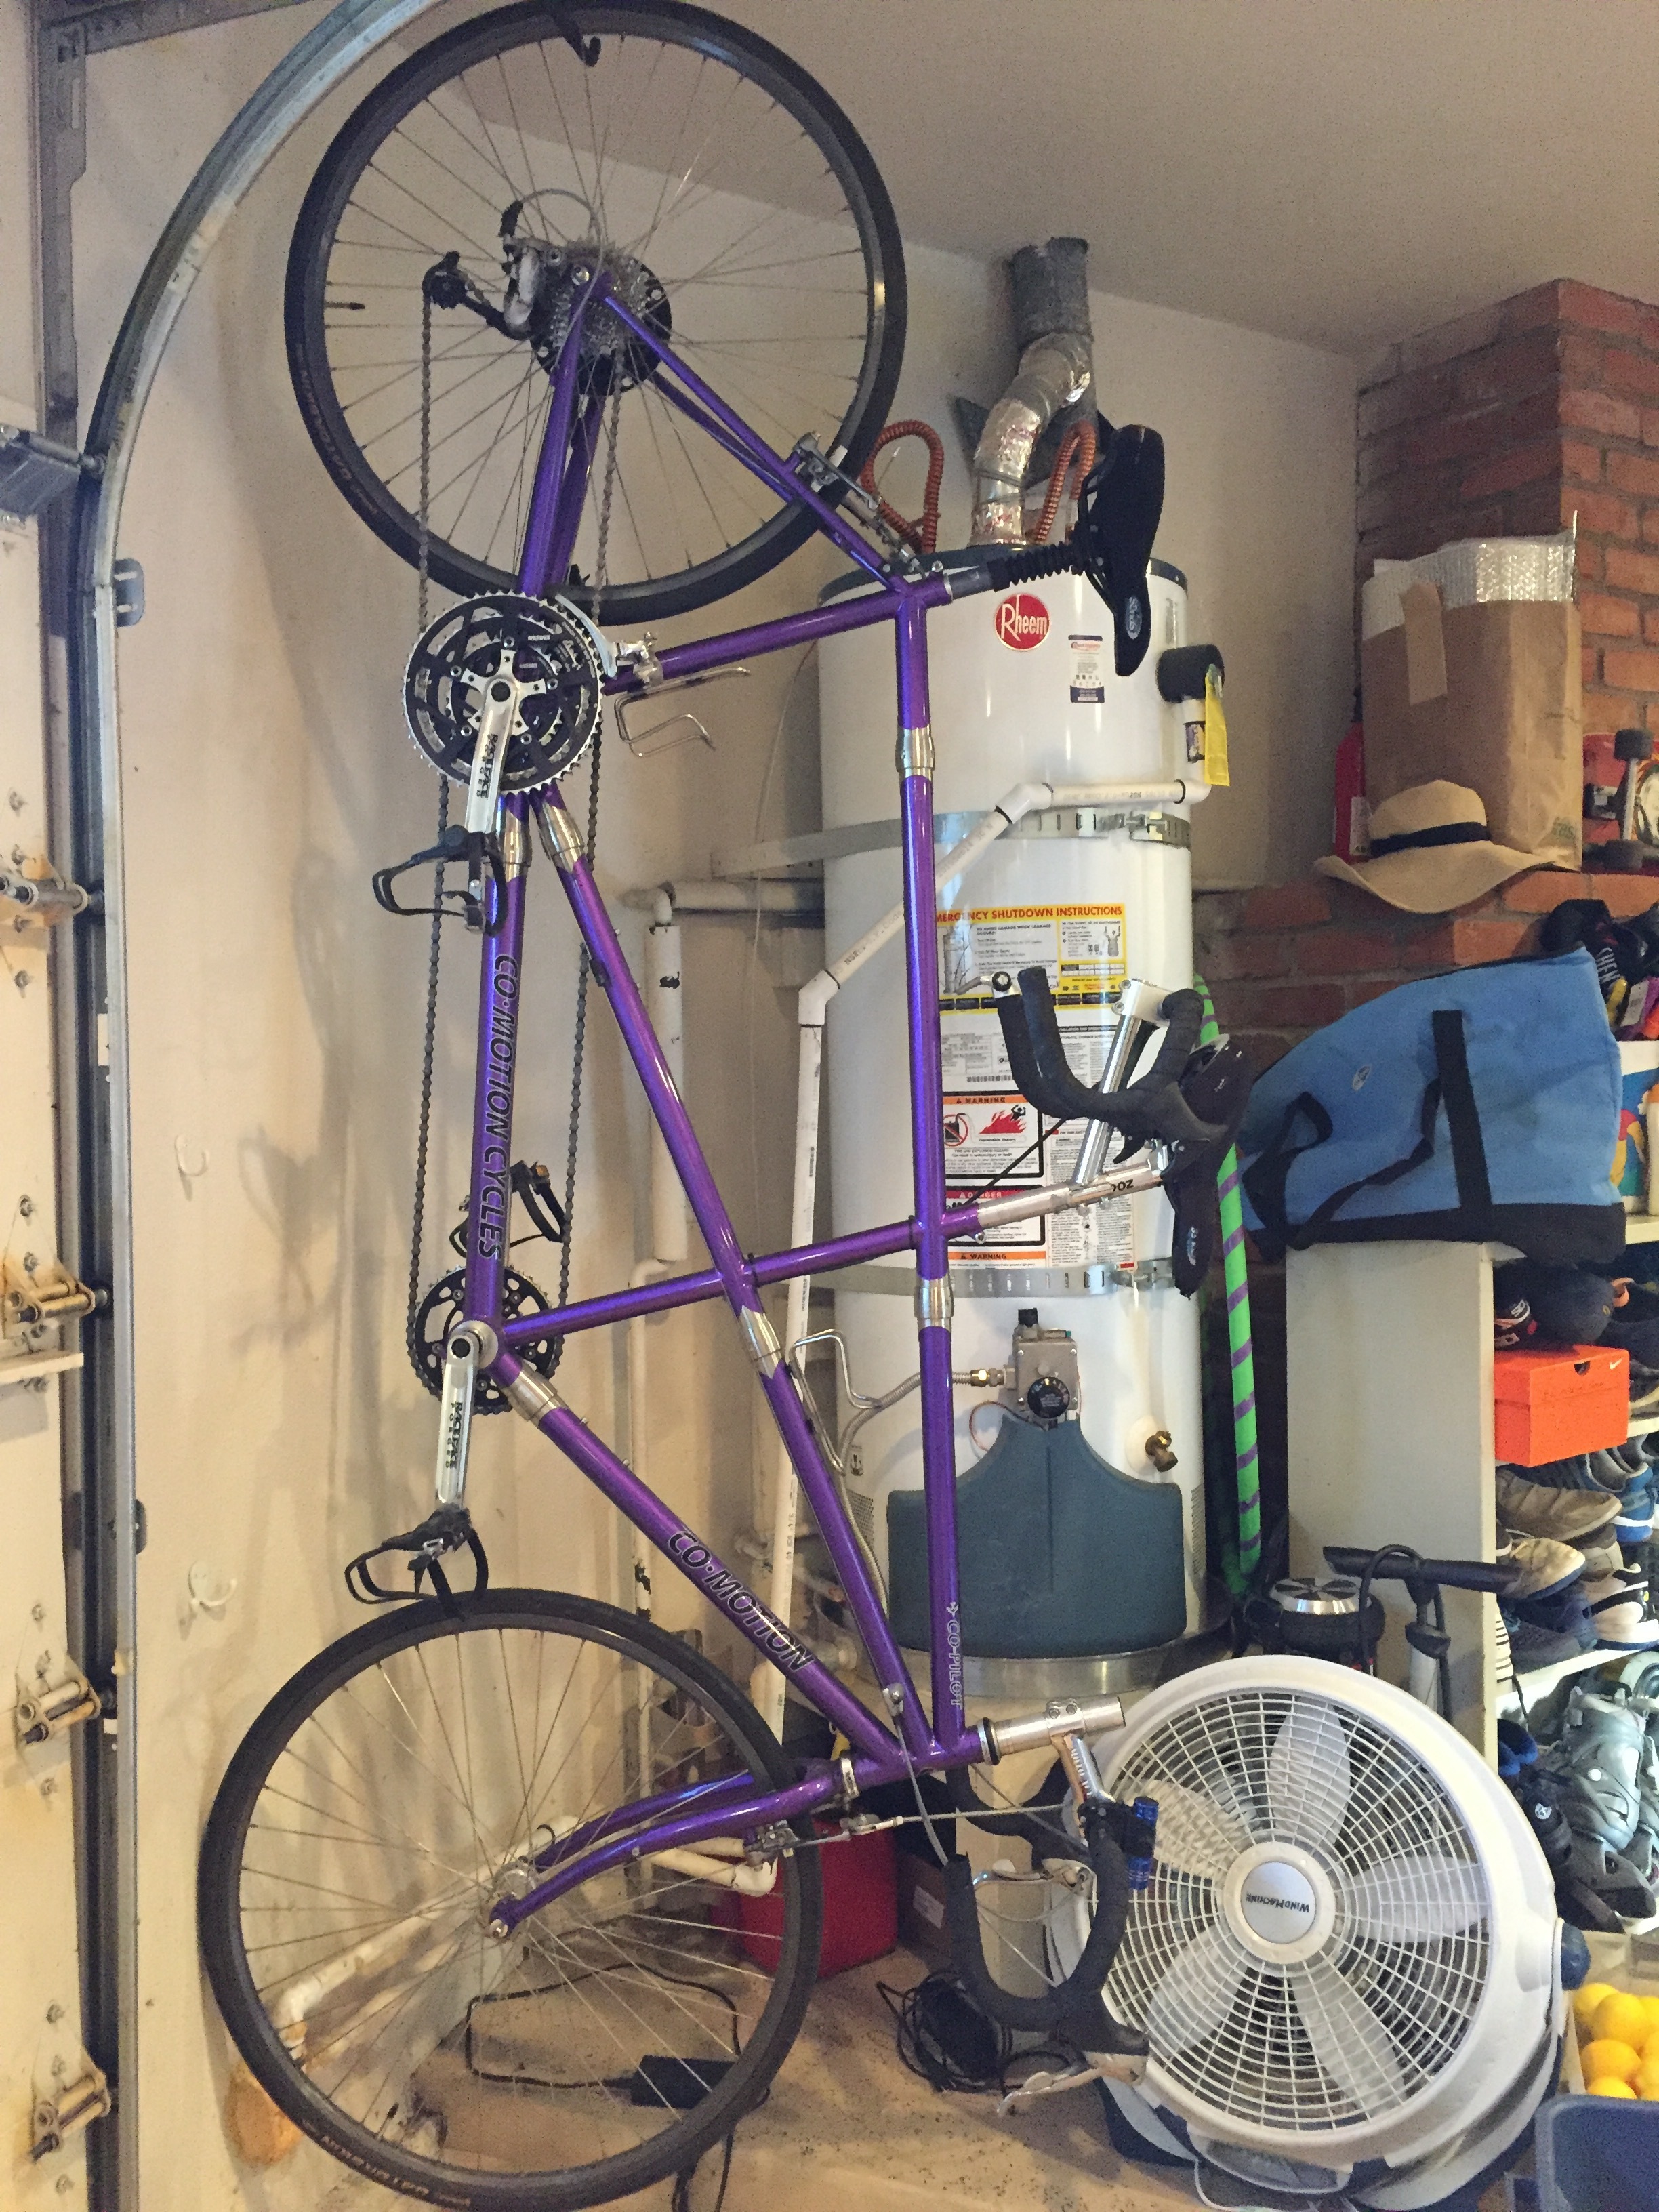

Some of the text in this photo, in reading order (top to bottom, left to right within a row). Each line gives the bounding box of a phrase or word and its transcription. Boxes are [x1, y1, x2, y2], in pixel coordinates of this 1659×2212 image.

[1001, 594, 1048, 642] Rheem
[937, 906, 1122, 922] MERGNCY SHUTDOWN INSTRUCTIONS
[478, 1145, 508, 1261] CYCLES
[947, 1619, 963, 1711] CO-PILOT
